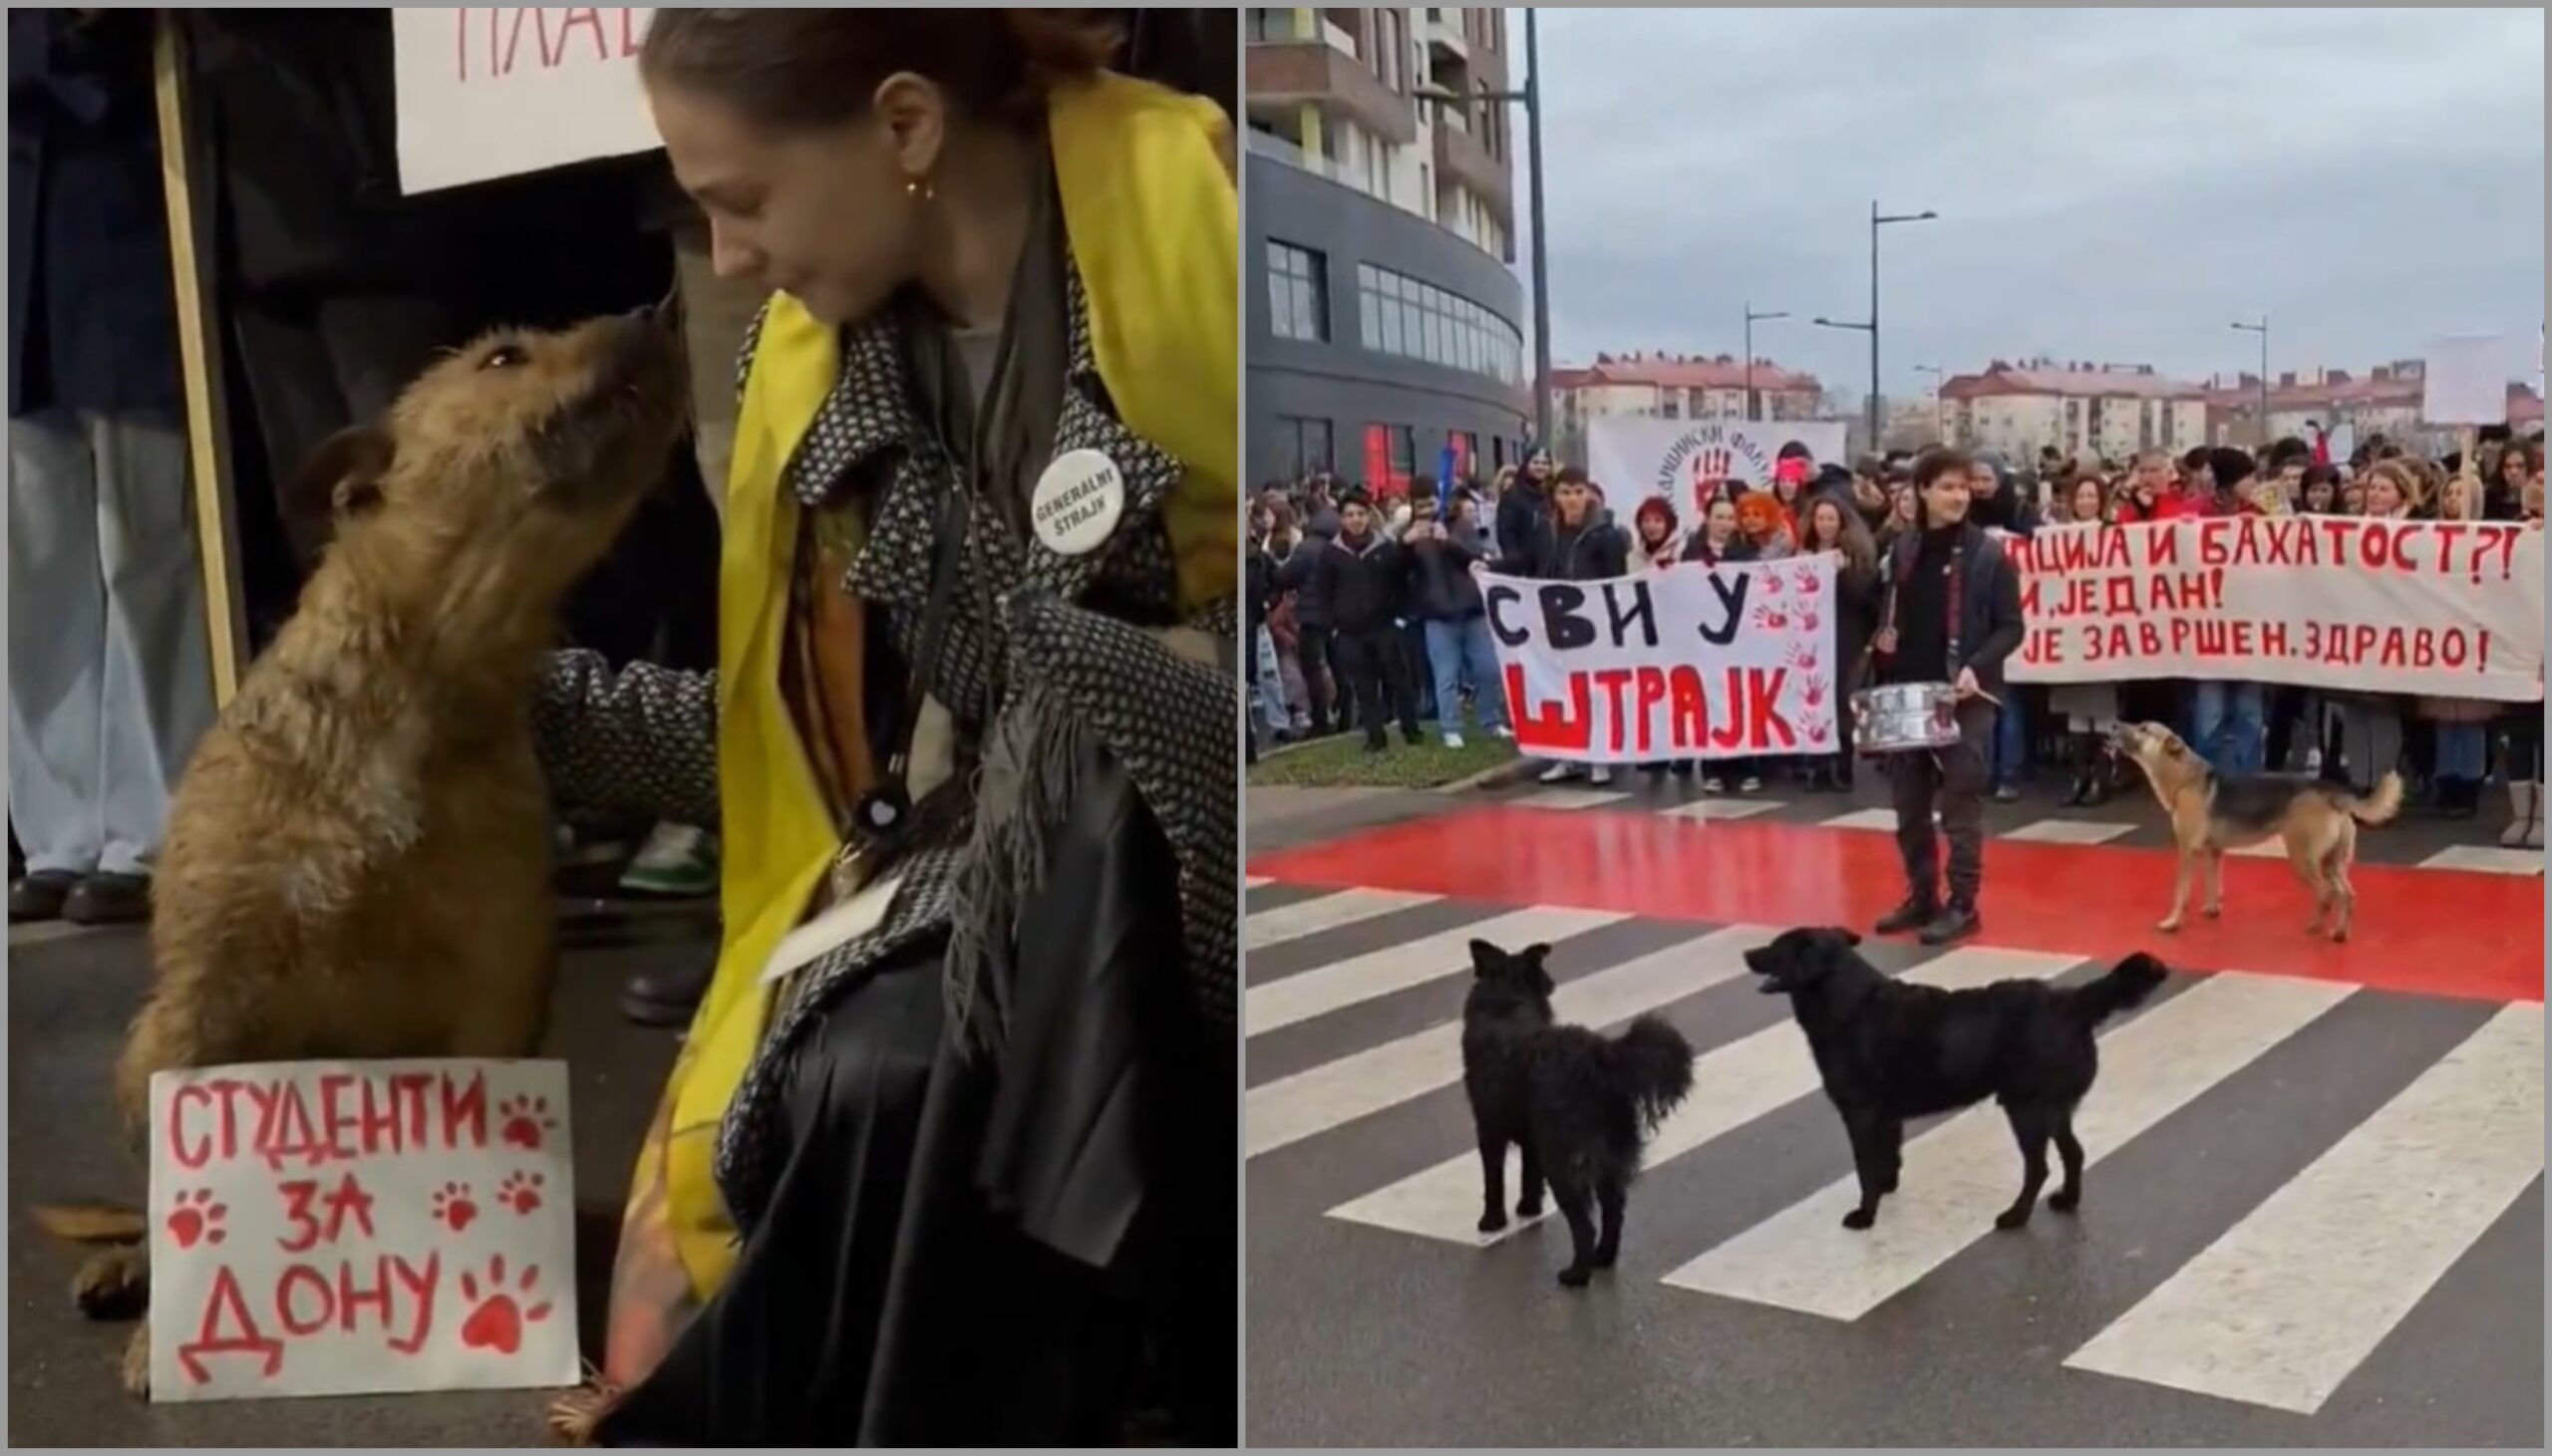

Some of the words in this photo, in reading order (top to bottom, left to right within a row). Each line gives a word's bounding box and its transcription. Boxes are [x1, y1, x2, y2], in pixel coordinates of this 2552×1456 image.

[1036, 467, 1114, 522] GENERALNI
[2147, 526, 2177, 565] И
[1486, 580, 1660, 650] СВИ
[1698, 571, 1751, 645] У
[1504, 662, 1798, 751] ШТРАЈК
[169, 1066, 488, 1172] СТУДЕНТИ
[276, 1172, 375, 1253] ЗА
[177, 1249, 441, 1385] ДОНУ
